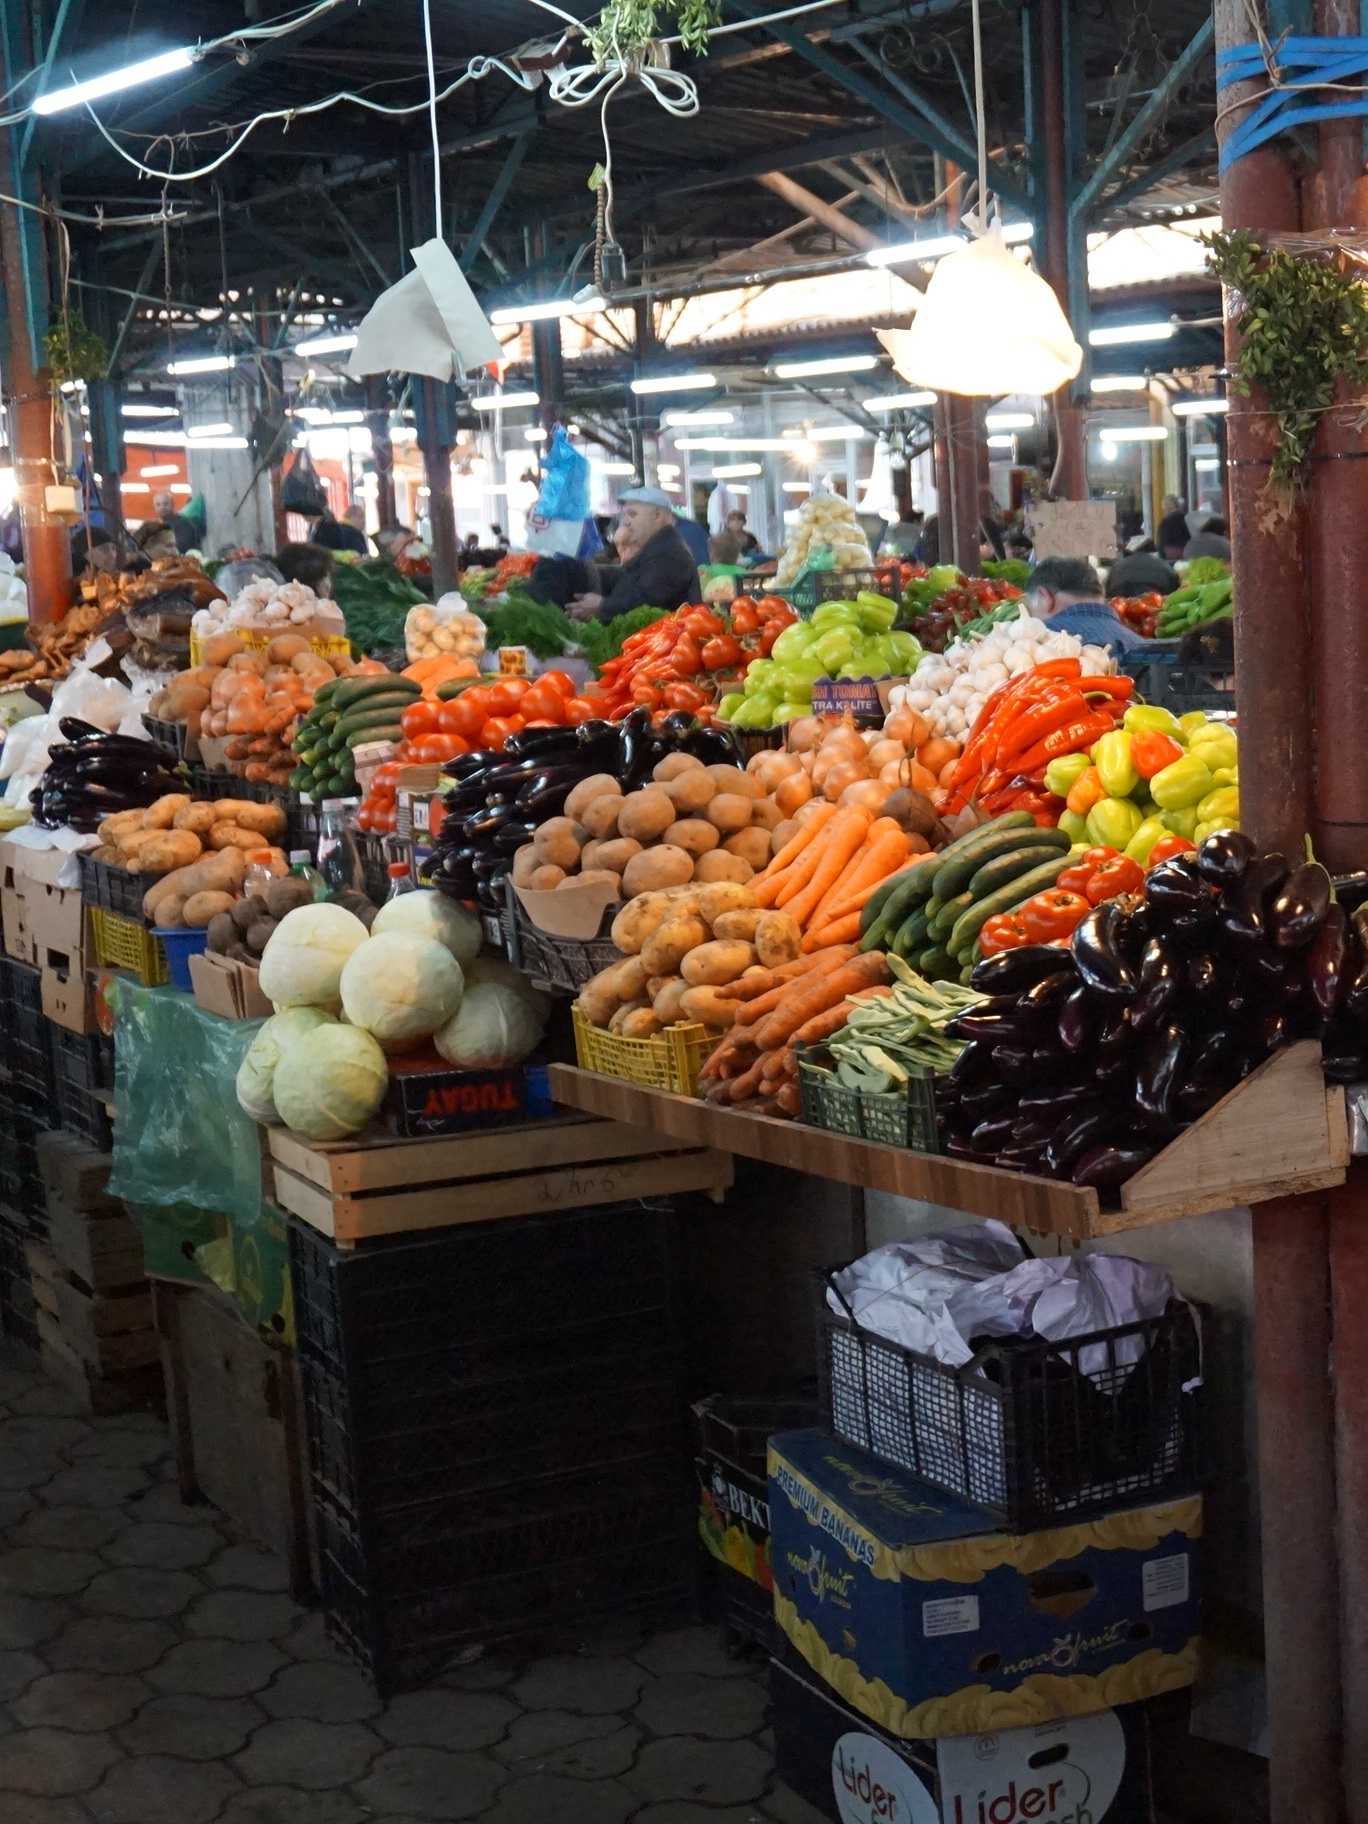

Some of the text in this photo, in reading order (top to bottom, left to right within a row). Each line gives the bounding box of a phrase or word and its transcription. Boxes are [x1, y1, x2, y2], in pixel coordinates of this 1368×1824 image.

[423, 1081, 520, 1115] TUGAY
[777, 1464, 877, 1567] PREMIUM BANANAS
[838, 1745, 896, 1821] Lider
[954, 1780, 1063, 1824] Lider
